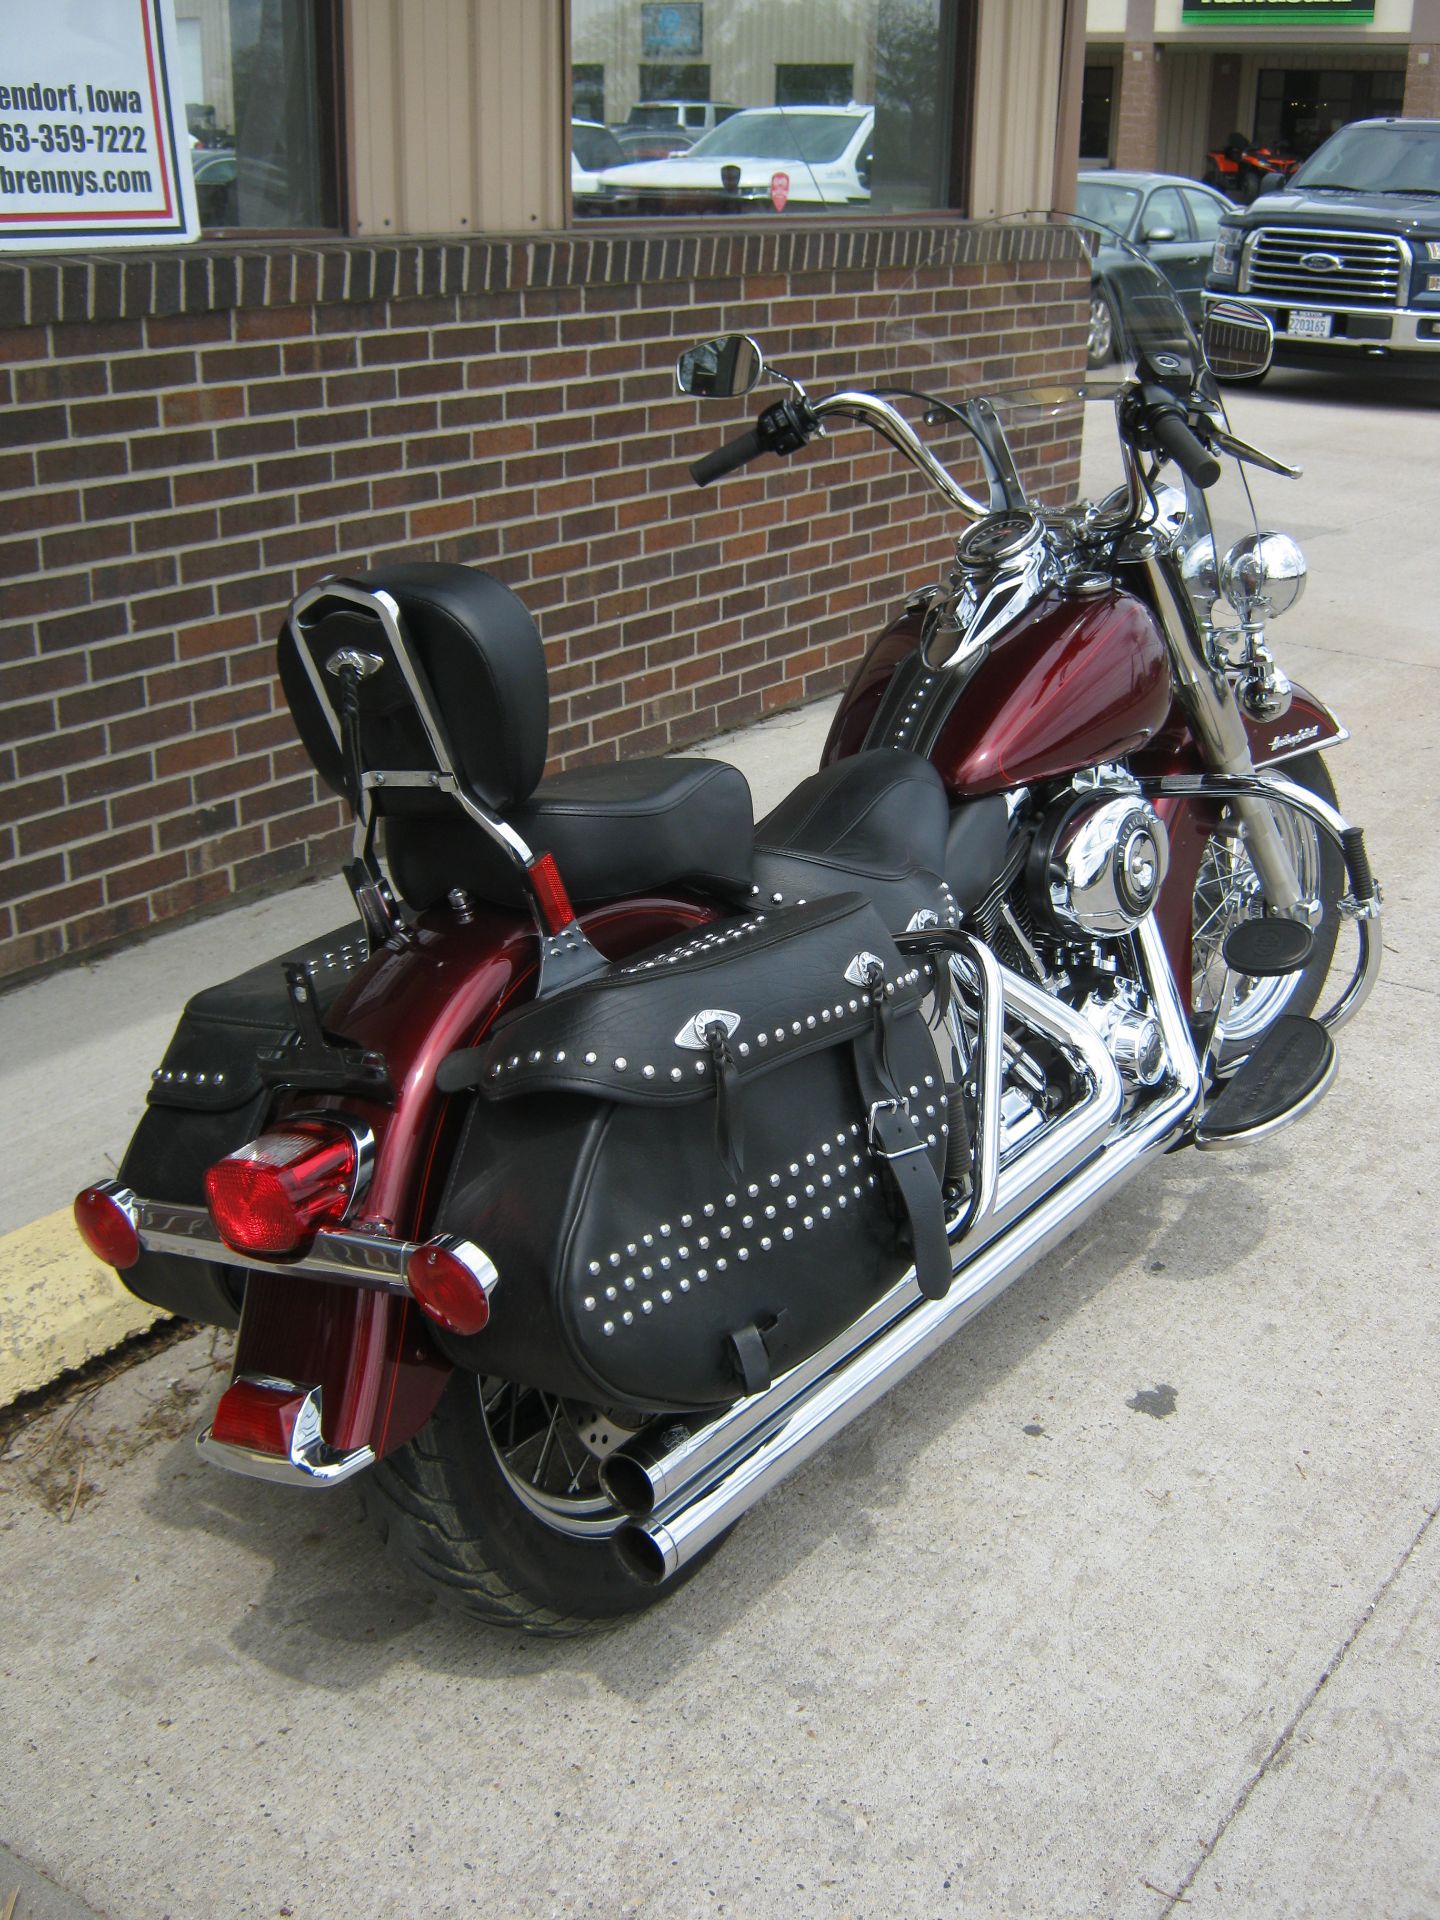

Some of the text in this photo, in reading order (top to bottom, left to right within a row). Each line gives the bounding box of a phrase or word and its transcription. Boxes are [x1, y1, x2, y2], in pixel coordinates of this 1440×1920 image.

[0, 83, 143, 114] endorf, Iowa
[0, 123, 147, 153] 63-359-7222
[0, 166, 152, 196] brennys.com
